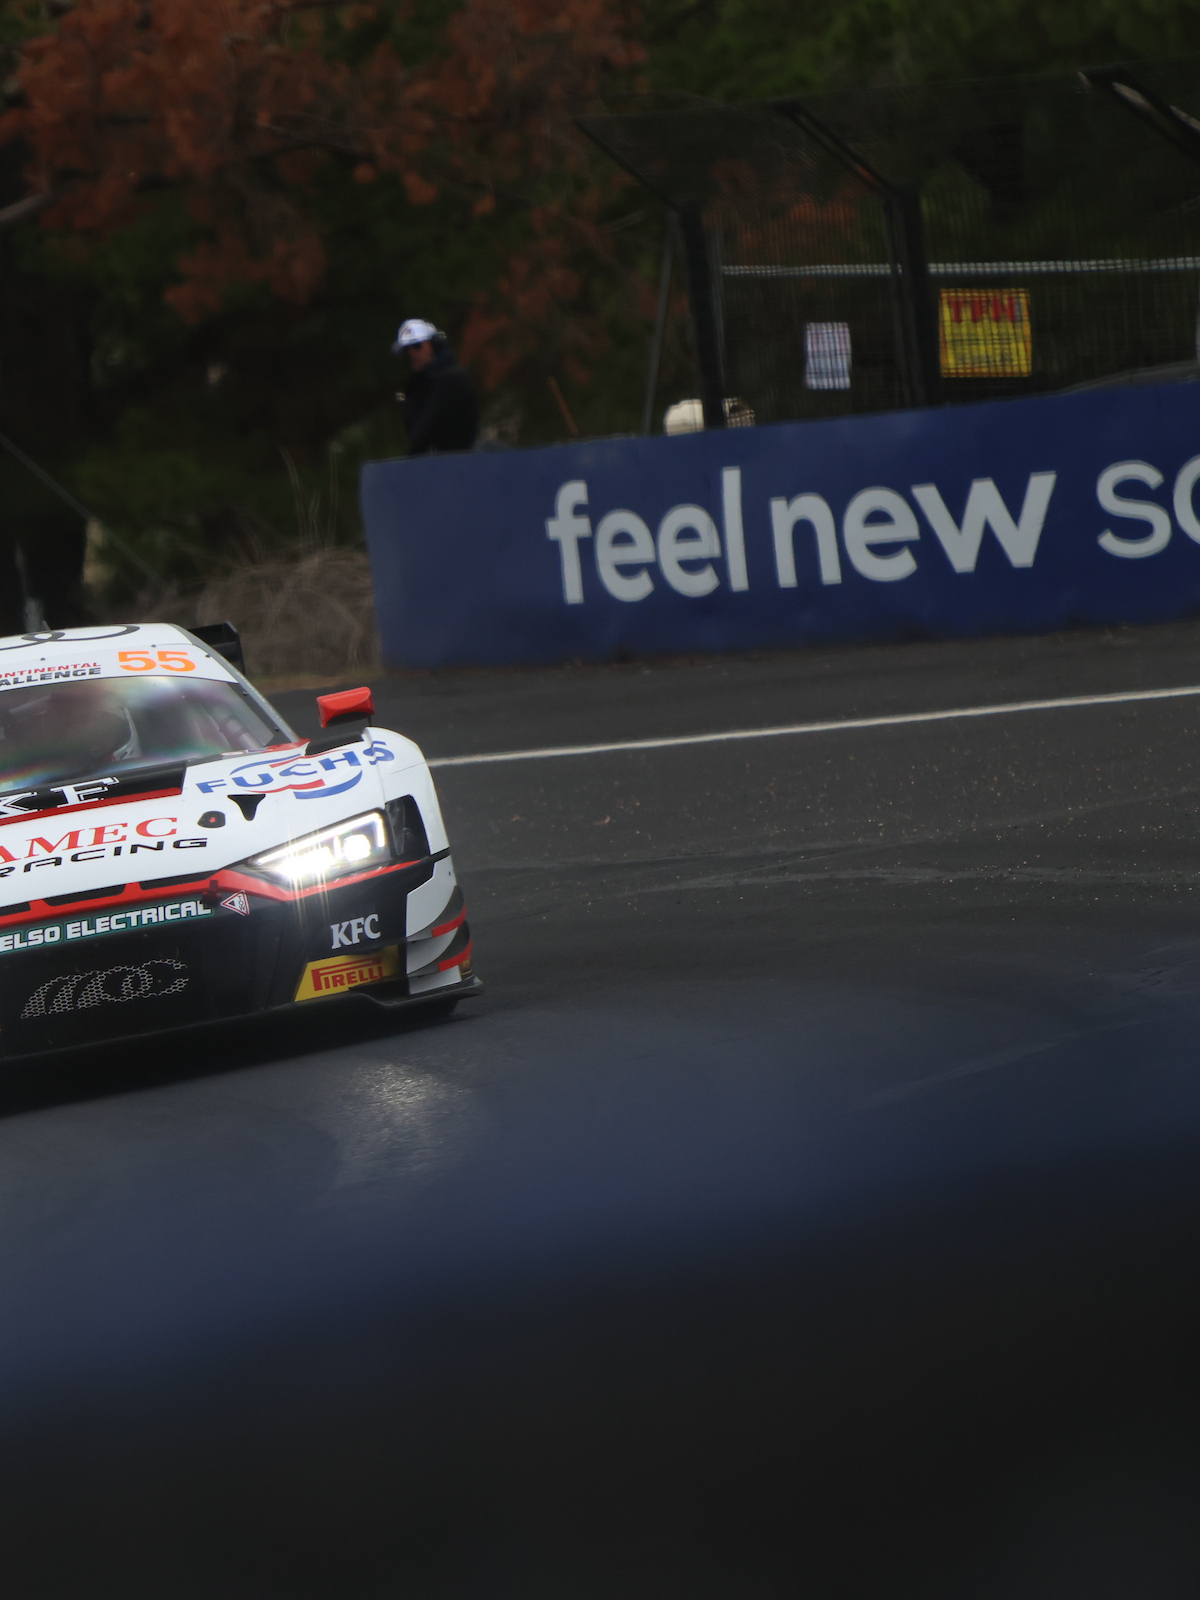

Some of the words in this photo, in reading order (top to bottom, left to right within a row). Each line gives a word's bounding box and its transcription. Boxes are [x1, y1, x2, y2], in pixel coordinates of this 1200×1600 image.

[546, 465, 748, 604] feel
[771, 471, 1057, 588] new
[117, 650, 197, 673] 55
[196, 740, 395, 794] FUCHS
[65, 900, 212, 940] ELECTRICAL
[330, 913, 382, 950] KFC
[311, 956, 384, 992] PIRELLI
